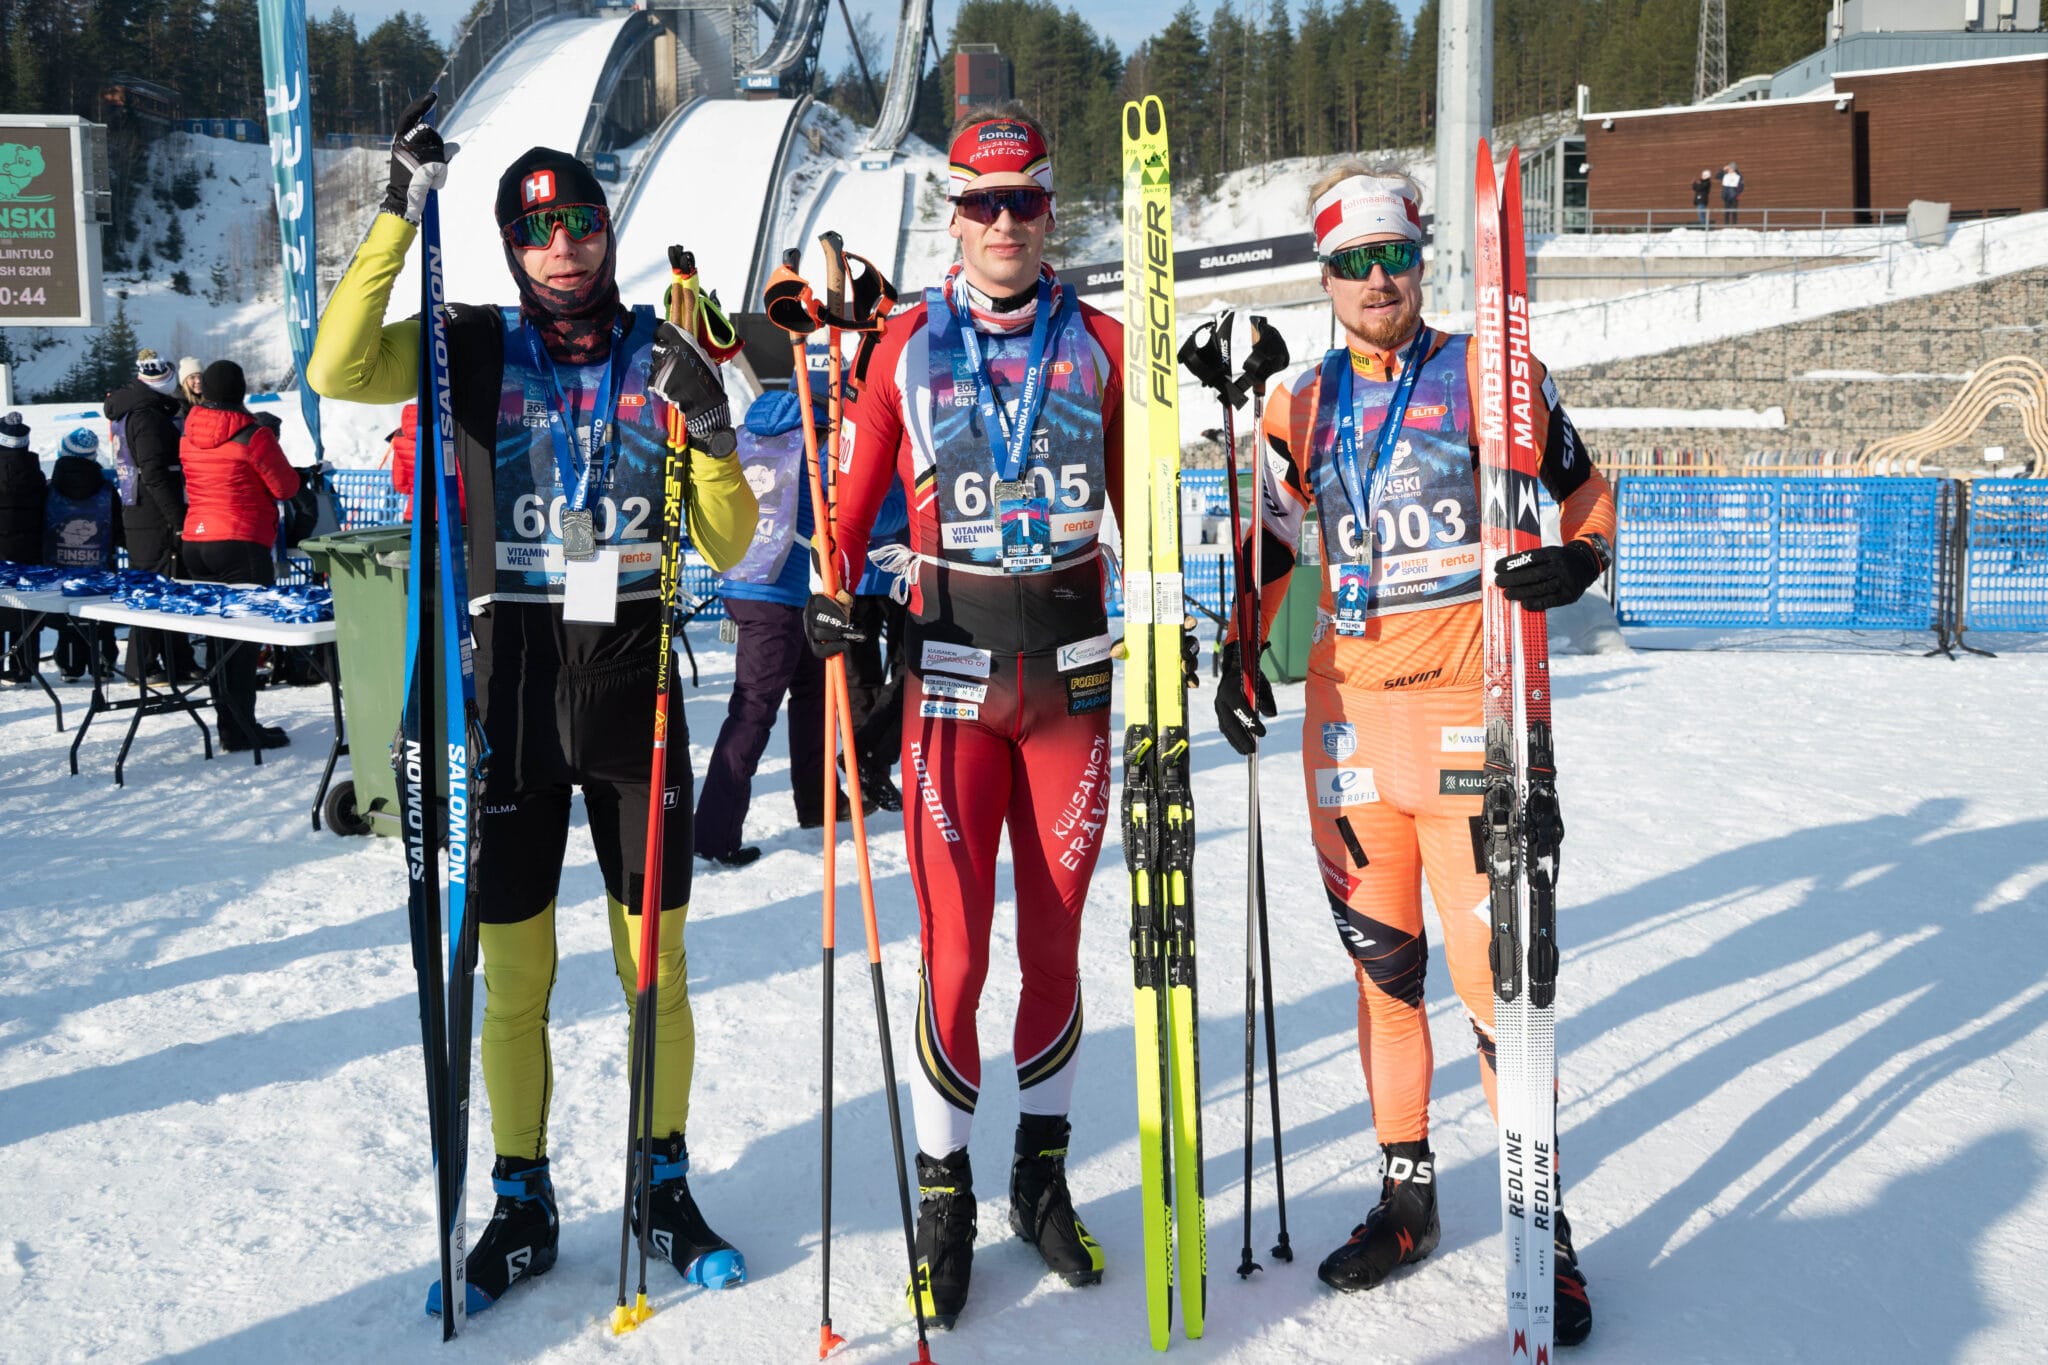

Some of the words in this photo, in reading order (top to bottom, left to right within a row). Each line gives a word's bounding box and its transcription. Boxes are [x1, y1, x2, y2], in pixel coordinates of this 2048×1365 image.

[979, 131, 1027, 142] FORDIA
[1199, 249, 1273, 269] SALOMON
[19, 266, 52, 276] 62KM
[1127, 204, 1147, 408] FISCHER
[1147, 200, 1174, 409] FISCHER
[429, 244, 453, 438] SALOMON
[1480, 285, 1505, 441] MADSHUS
[1507, 293, 1533, 449] MADSHUS
[954, 397, 969, 407] 62
[1010, 366, 1038, 464] FINLANDIA-HIIHTO
[1411, 407, 1440, 418] ELITE
[668, 461, 683, 527] LEKI
[951, 525, 994, 536] VITAMIN
[1017, 512, 1030, 537] 1
[1063, 519, 1095, 533] renta
[952, 534, 978, 544] WELL
[57, 549, 100, 561] FINSKI
[507, 547, 549, 557] VITAMIN
[507, 556, 532, 566] WELL
[620, 552, 652, 564] renta
[1440, 551, 1476, 569] renta
[1401, 558, 1429, 568] INTER
[1401, 565, 1429, 577] SPORT
[1345, 577, 1359, 602] 3
[1376, 580, 1438, 599] SALOMON
[1070, 671, 1111, 691] FORDIA
[1383, 667, 1443, 690] SILVINI
[910, 740, 961, 844] noname
[1051, 734, 1108, 841] KUUSAMON
[1319, 792, 1376, 806] ELECTROFIT
[406, 739, 425, 883] SALOMON
[448, 742, 467, 884] SALOMON
[1506, 1129, 1525, 1220] REDLINE
[1534, 1140, 1550, 1231] REDLINE
[1511, 1291, 1527, 1300] 192
[1534, 1305, 1549, 1314] 192
